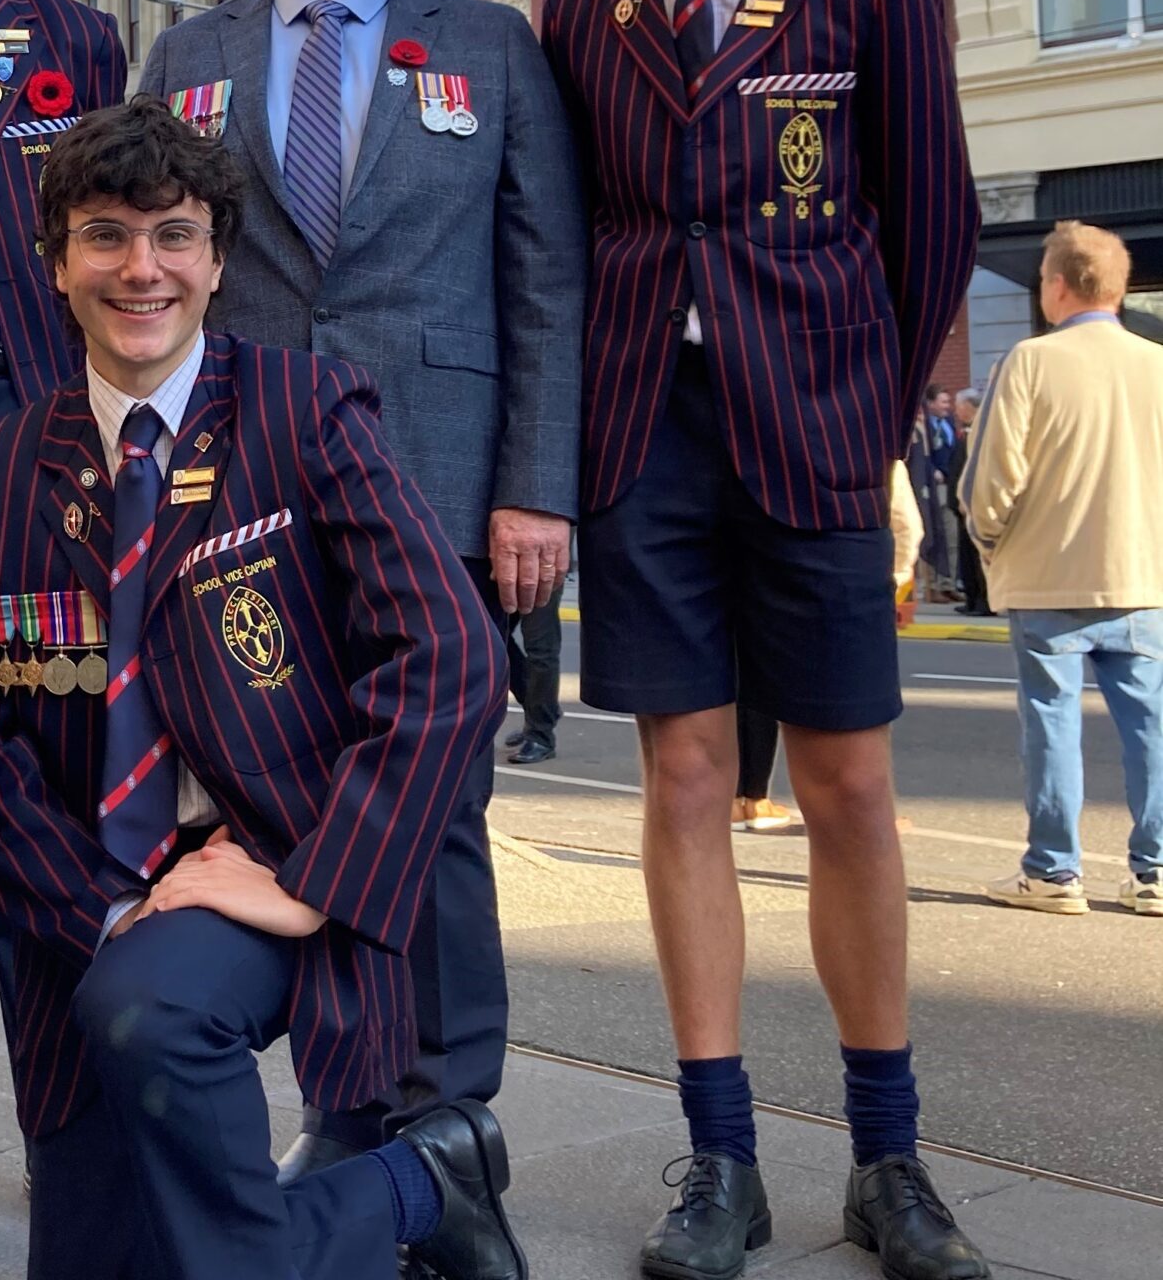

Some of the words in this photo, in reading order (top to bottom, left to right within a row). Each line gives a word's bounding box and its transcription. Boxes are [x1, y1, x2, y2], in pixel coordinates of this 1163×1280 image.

[193, 576, 224, 597] SCHOOL
[224, 568, 244, 583] VICE
[244, 556, 276, 577] CAPTAIN
[225, 590, 266, 621] ECCLESIA
[266, 611, 279, 630] DEI
[225, 625, 238, 647] PRO
